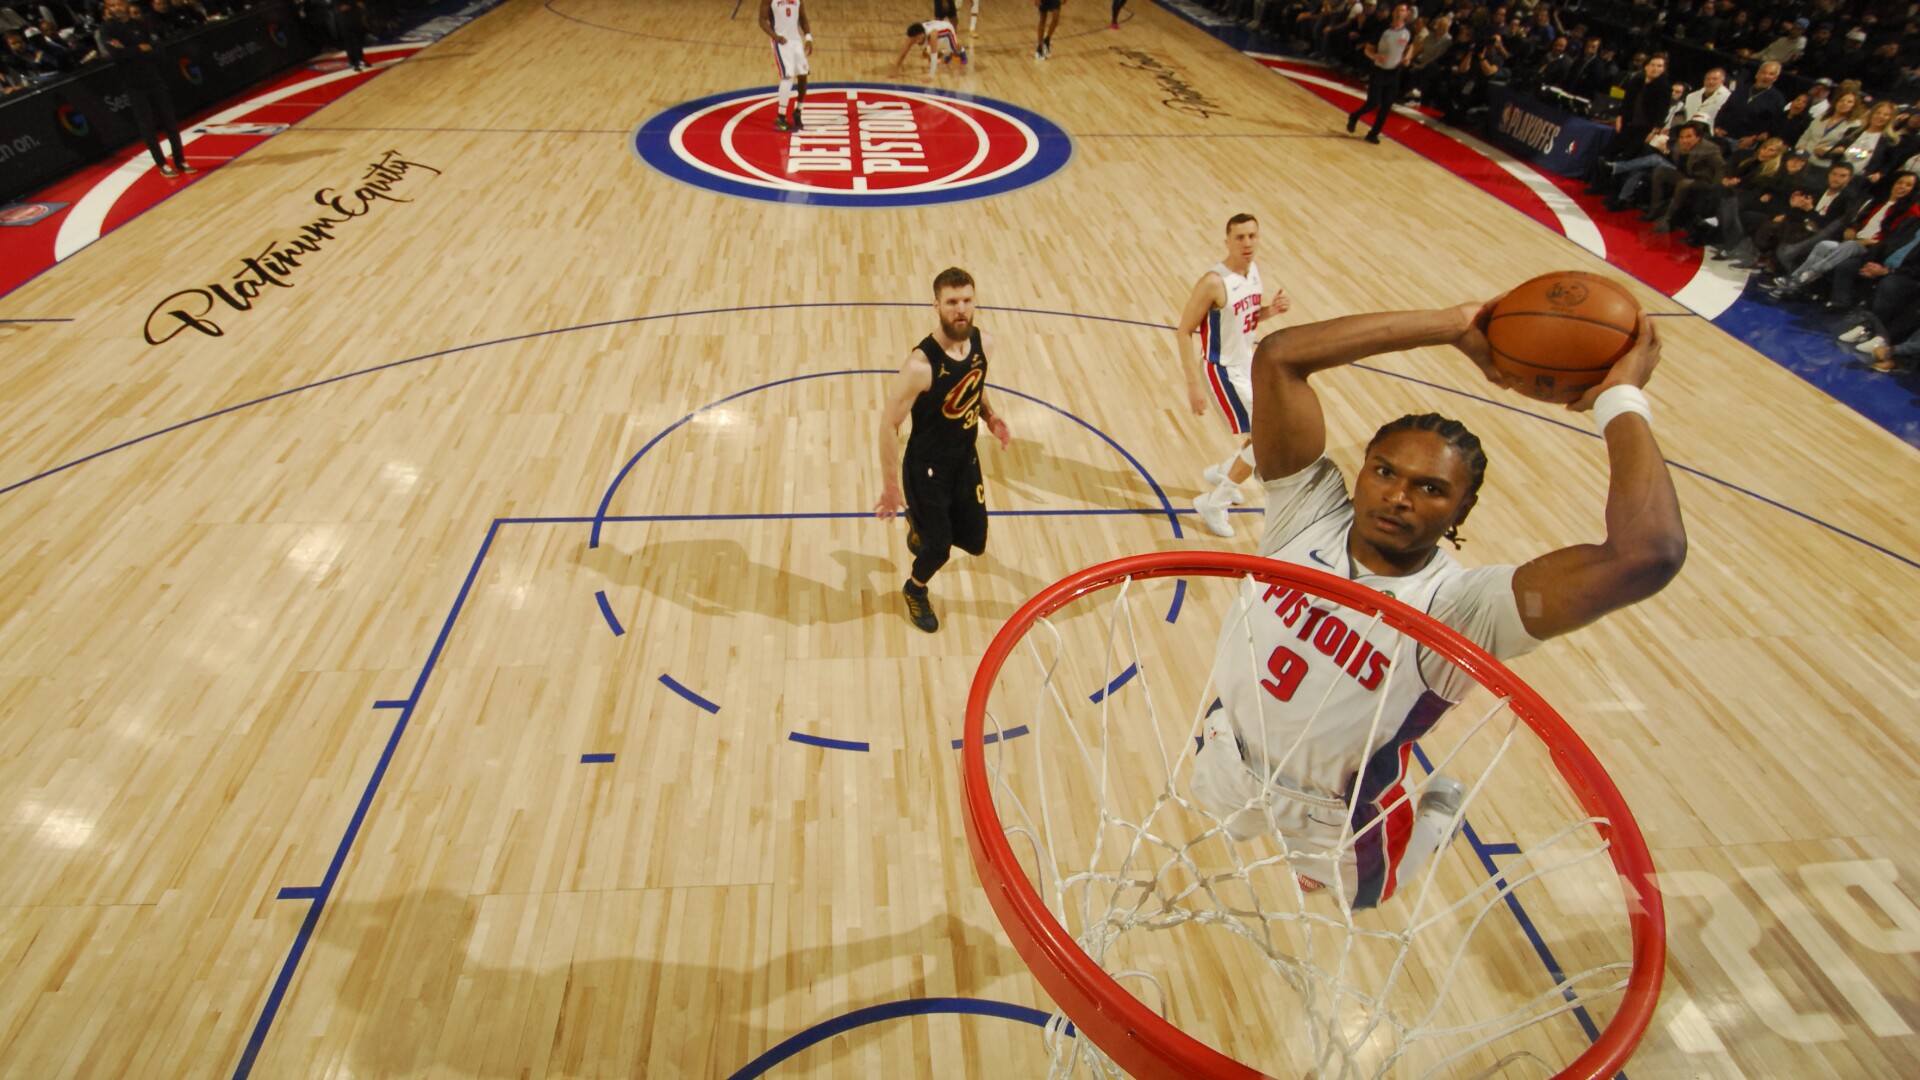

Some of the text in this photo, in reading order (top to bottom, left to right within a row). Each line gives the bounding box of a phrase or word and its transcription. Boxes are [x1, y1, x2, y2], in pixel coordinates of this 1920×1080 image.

[104, 94, 131, 112] Sea
[787, 101, 851, 174] DETROIT
[856, 101, 929, 174] PISTONS
[1506, 106, 1561, 155] PLAYOFFS
[143, 150, 442, 346] Platinum Equity
[1233, 294, 1261, 316] PISTO
[1243, 310, 1260, 333] 55
[963, 404, 980, 430] 32
[1262, 584, 1391, 691] PISTONS
[1260, 645, 1309, 702] 9
